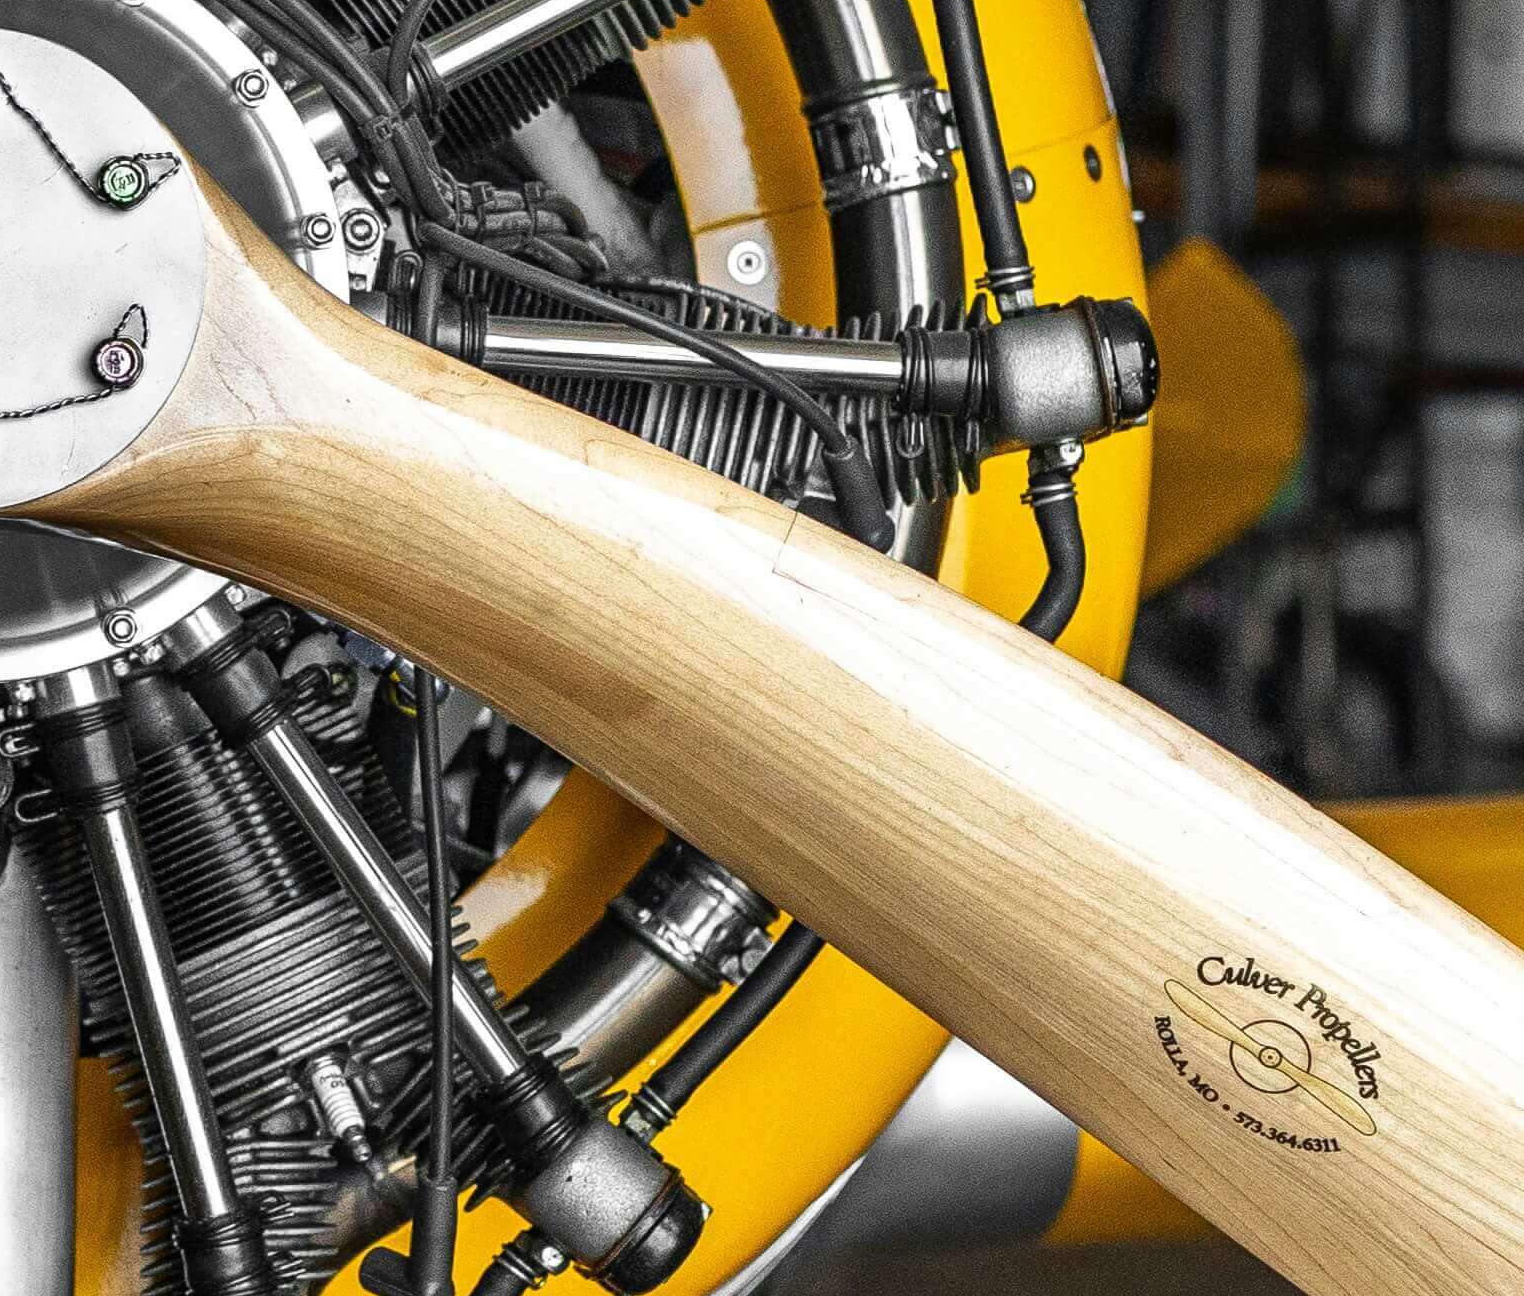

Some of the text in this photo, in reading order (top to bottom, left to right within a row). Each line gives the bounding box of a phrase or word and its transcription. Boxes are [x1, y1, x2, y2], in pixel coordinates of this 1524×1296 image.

[1154, 1016, 1342, 1153] ROLLA, MO 573.364.6311
[1197, 956, 1381, 1100] Culver Propellers
